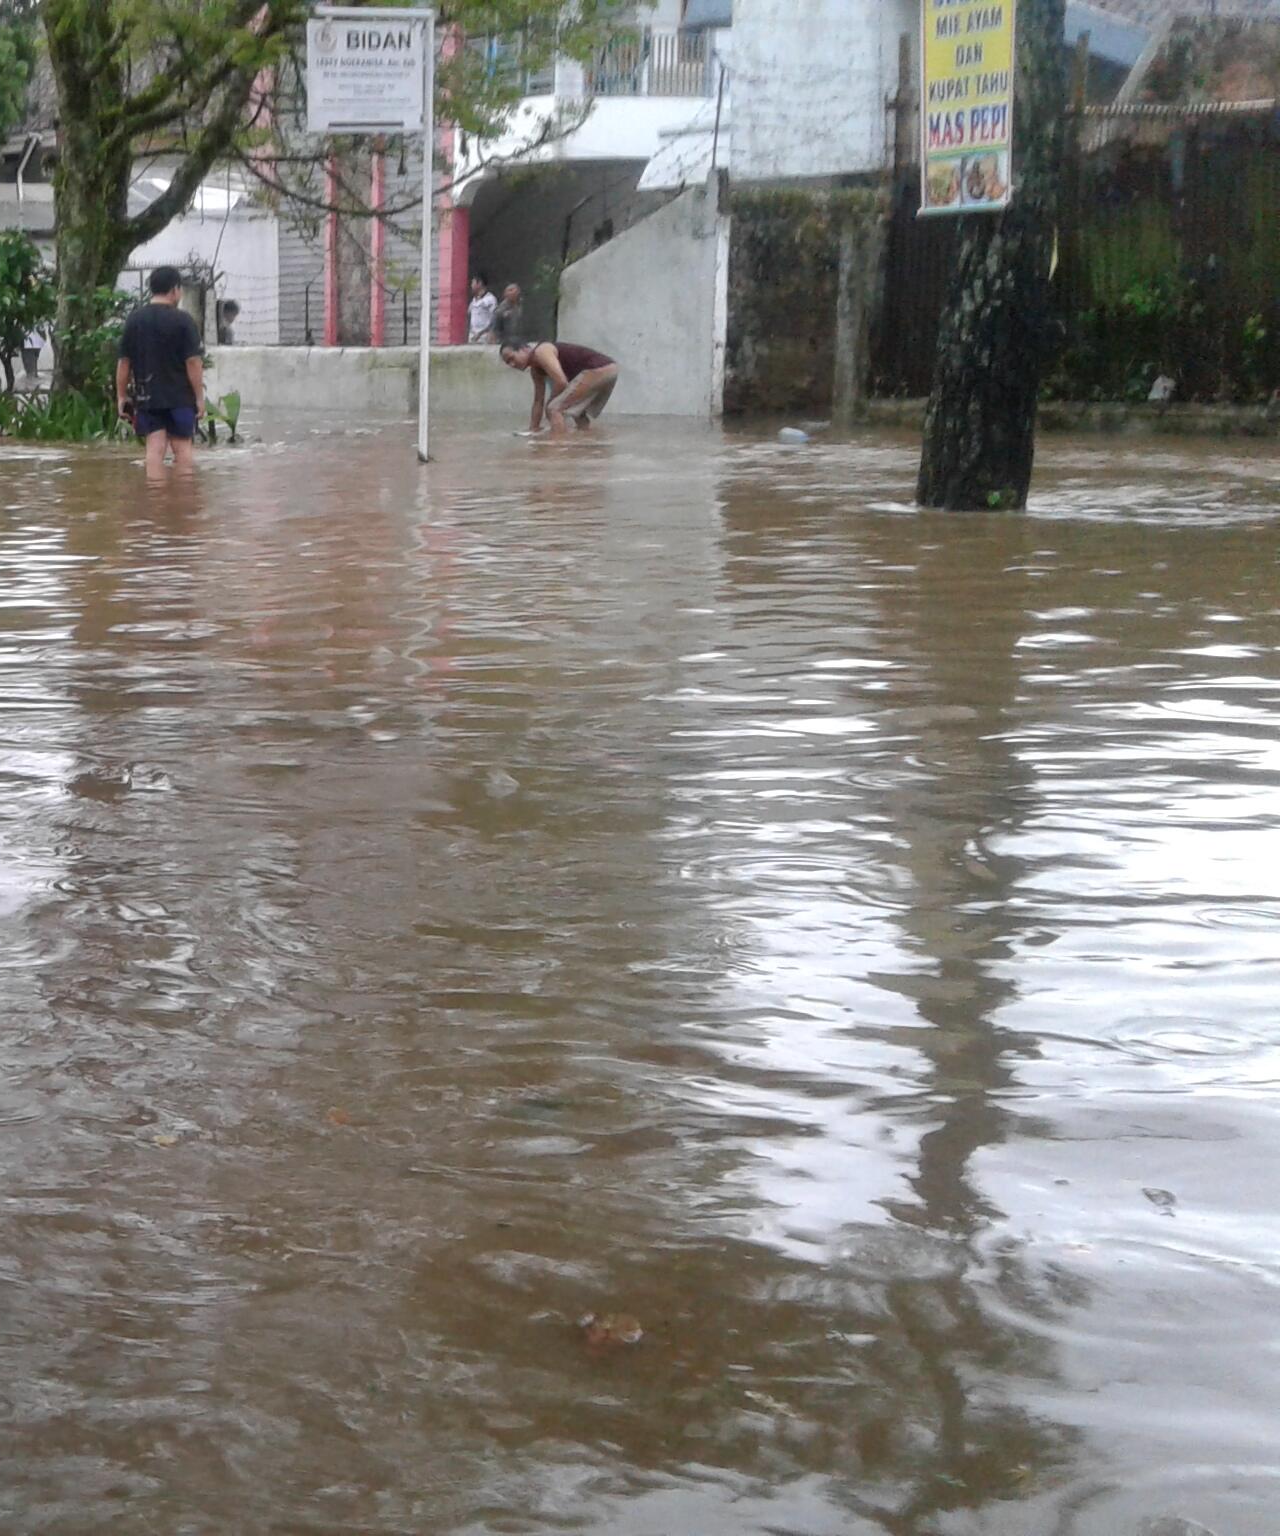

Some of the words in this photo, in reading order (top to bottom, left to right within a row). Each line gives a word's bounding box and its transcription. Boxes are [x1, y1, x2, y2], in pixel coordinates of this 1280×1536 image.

[935, 14, 960, 37] MIE
[967, 6, 1002, 33] AYAM
[347, 29, 411, 51] BIDAN
[955, 42, 983, 67] DAN
[929, 76, 969, 103] KUPAT
[976, 71, 1008, 97] TAHU
[928, 108, 966, 147] MAS
[970, 104, 1008, 144] PEPI
